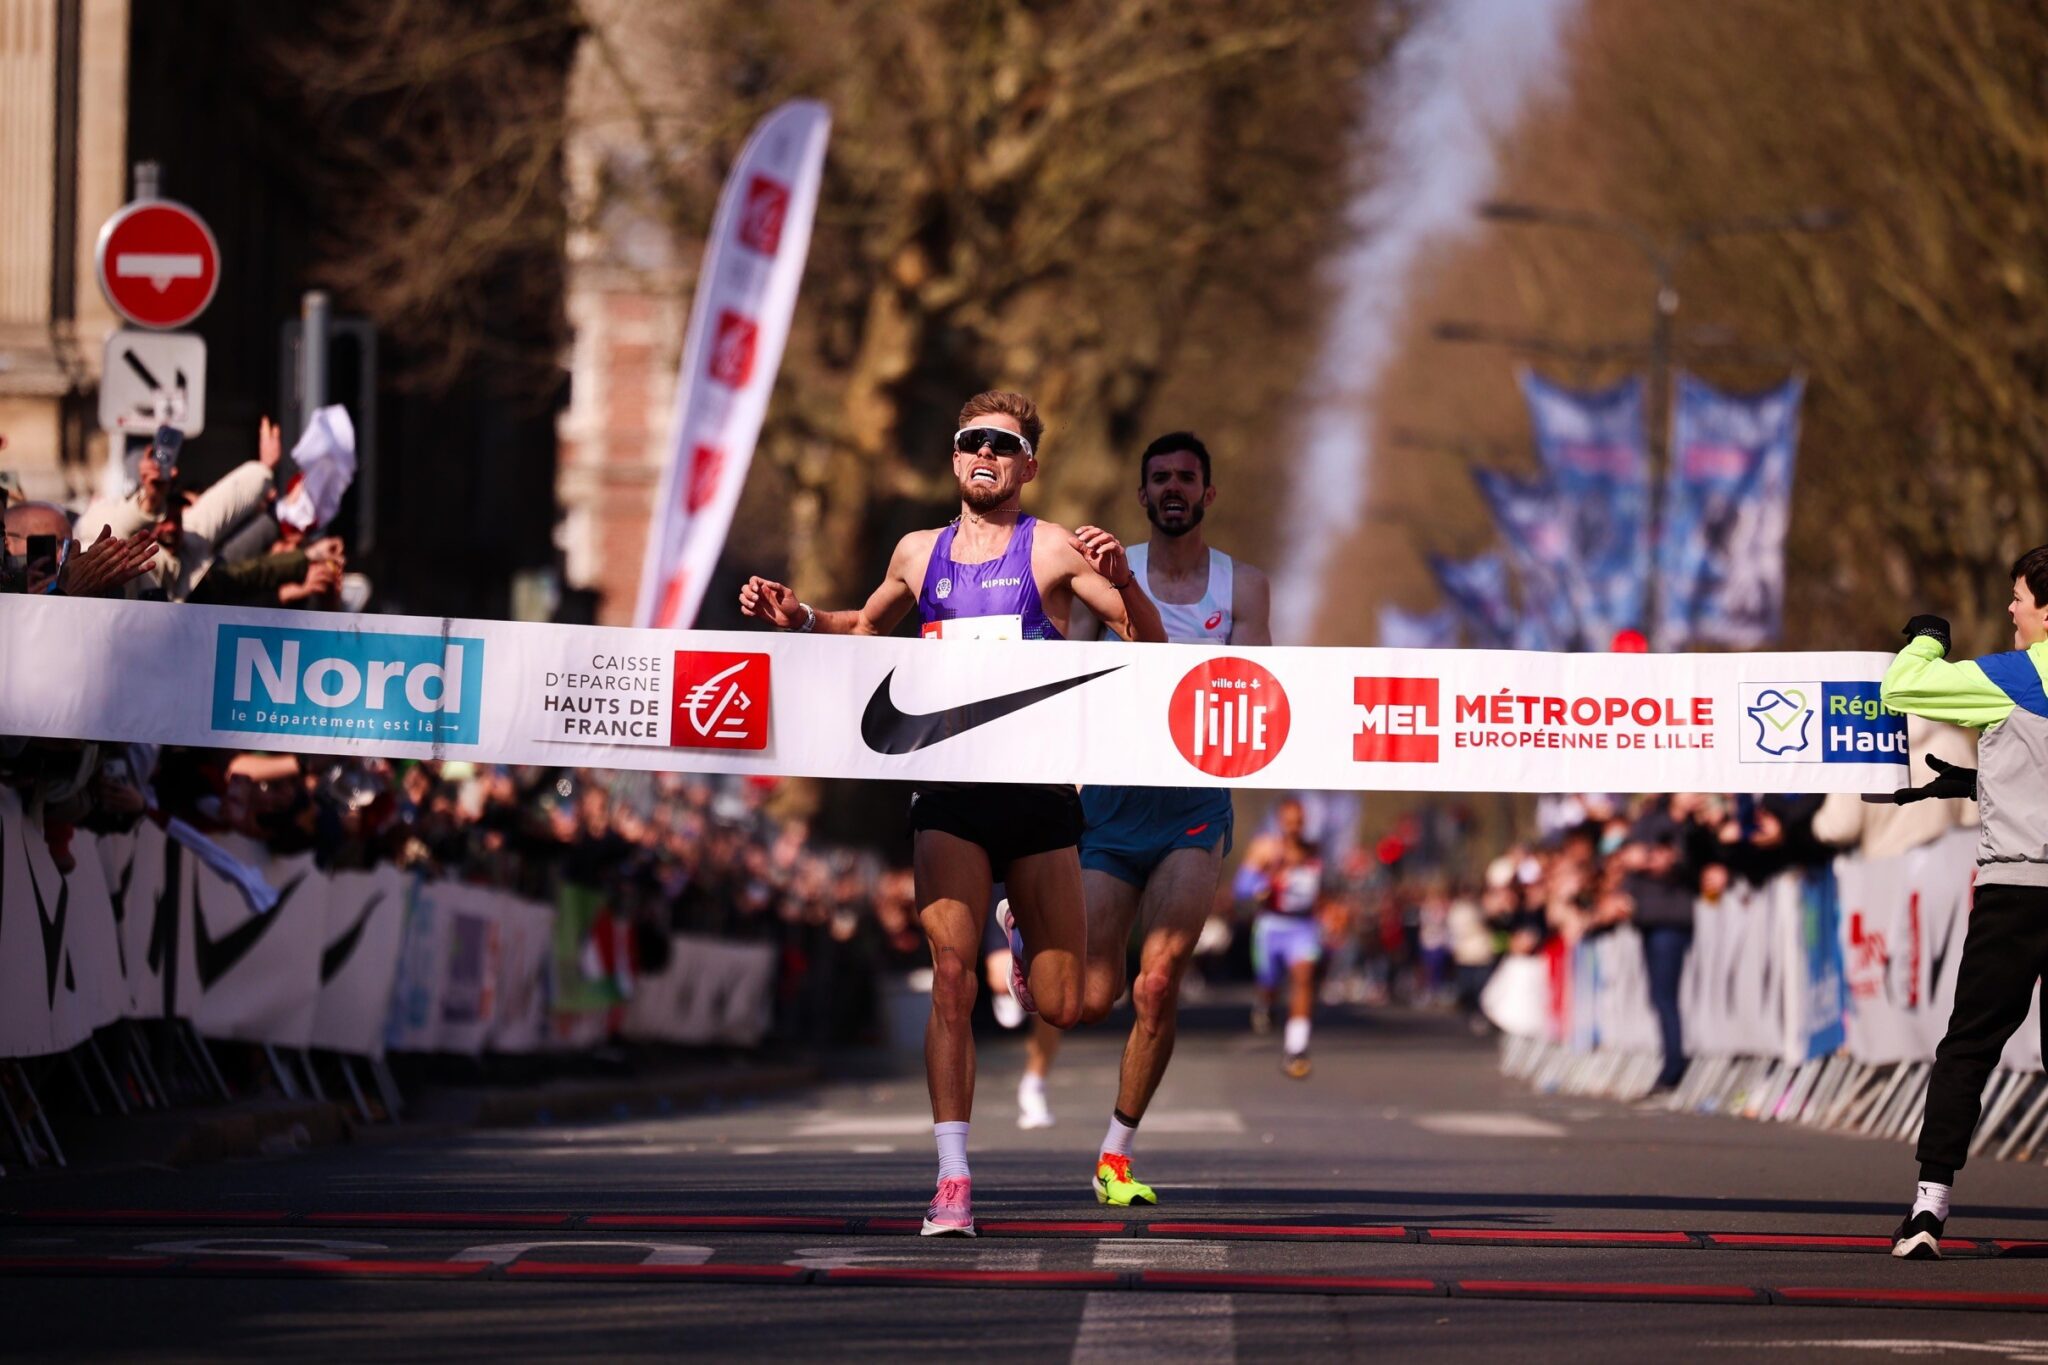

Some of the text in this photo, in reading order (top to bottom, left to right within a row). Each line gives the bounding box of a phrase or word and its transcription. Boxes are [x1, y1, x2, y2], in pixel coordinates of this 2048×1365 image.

[982, 577, 1021, 589] KIPRUN
[592, 654, 661, 672] CAISSE
[233, 637, 465, 714] Nord
[545, 672, 660, 692] D'EPARGNE
[1211, 678, 1247, 689] ville de
[544, 695, 659, 716] HAUTS DE
[1455, 687, 1714, 727] MÉTROPOLE
[231, 709, 434, 732] le Département est là
[564, 718, 658, 738] FRANCE
[1353, 703, 1439, 736] MEL
[1455, 728, 1714, 749] EUROPÉENNE DE LILLE
